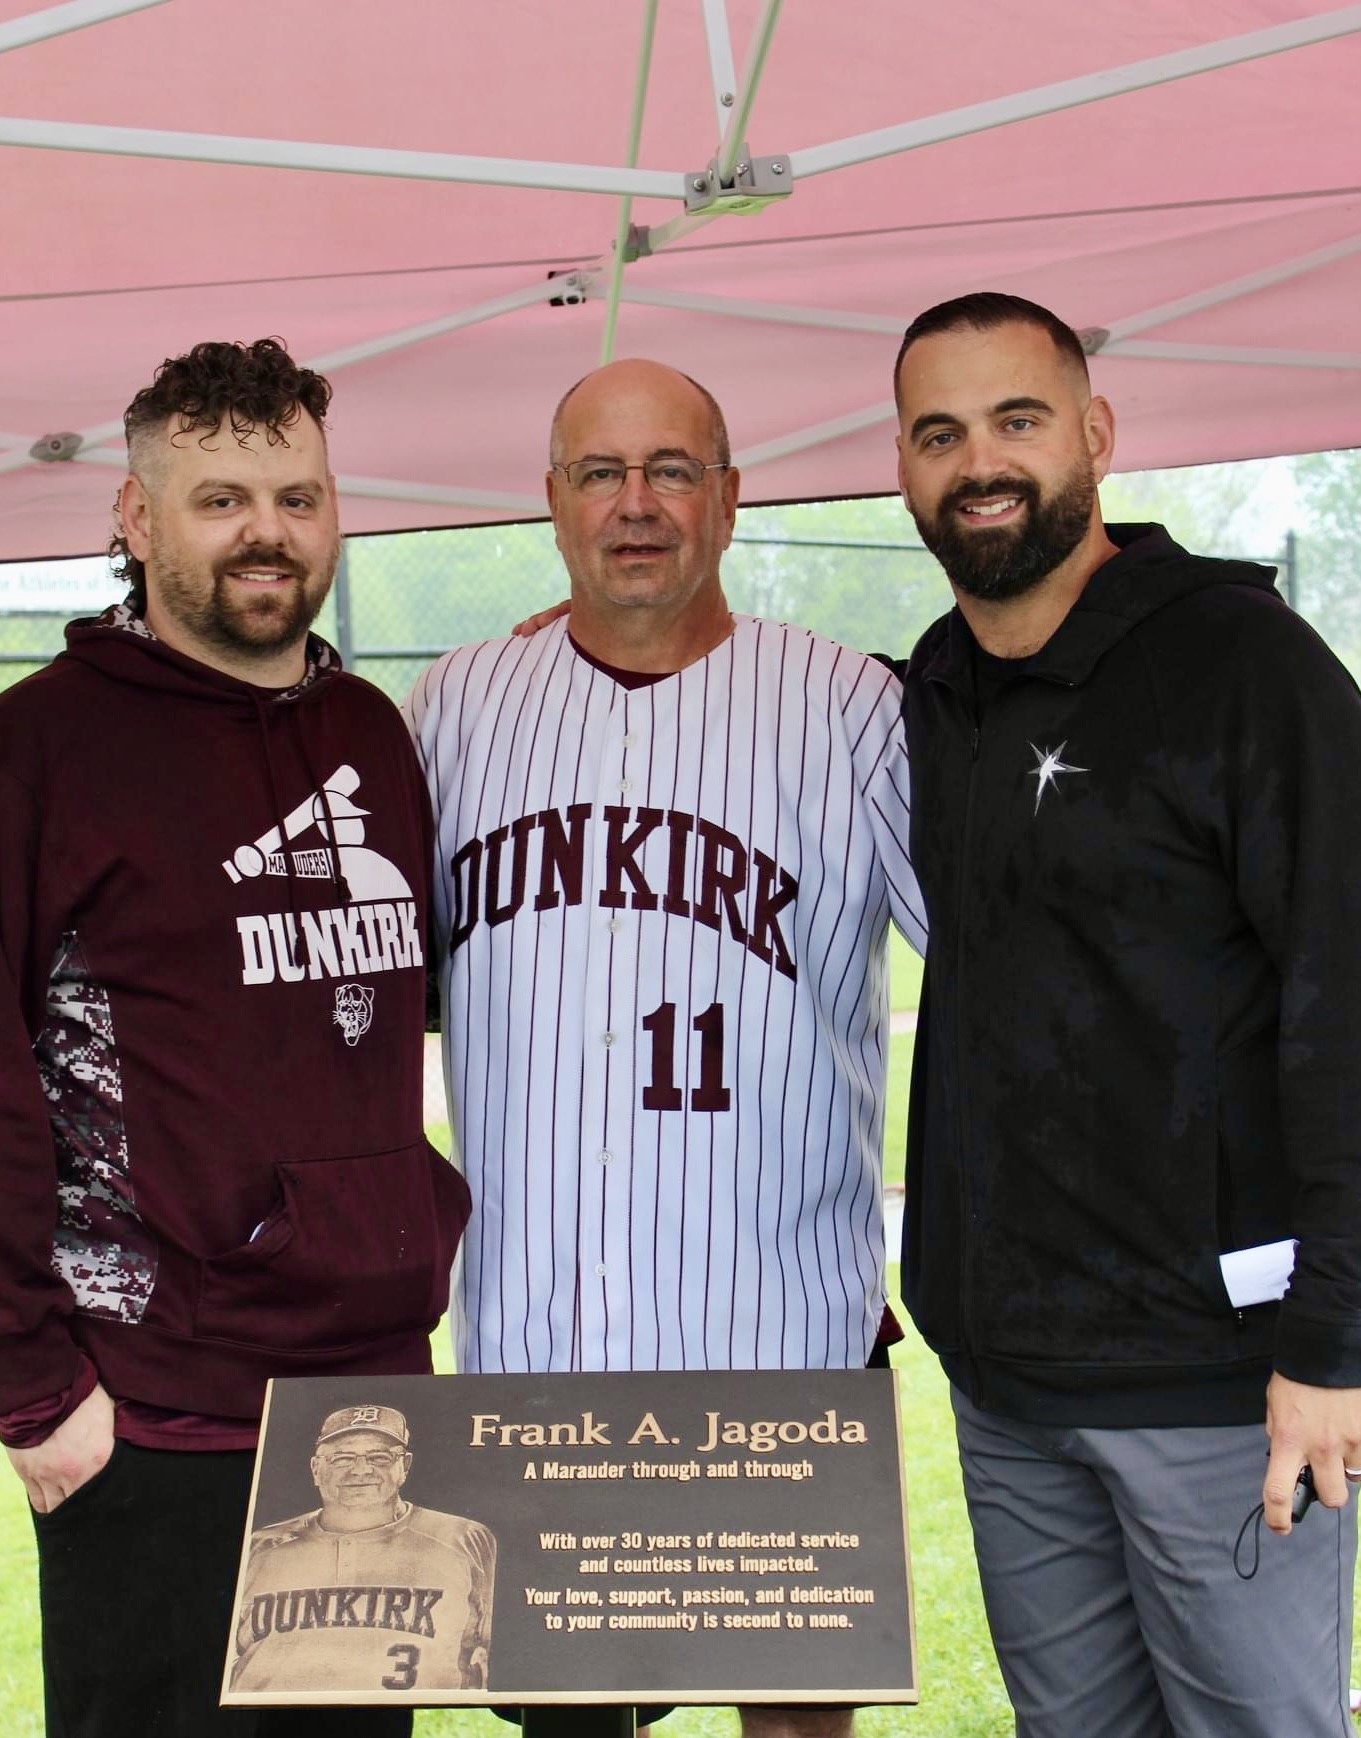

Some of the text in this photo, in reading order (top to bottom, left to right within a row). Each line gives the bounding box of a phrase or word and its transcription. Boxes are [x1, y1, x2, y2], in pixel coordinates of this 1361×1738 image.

[268, 851, 328, 876] MAUDERS
[450, 803, 798, 984] DUNKIRK
[236, 902, 424, 985] DUNKIRK
[643, 1002, 731, 1112] 11
[469, 1410, 868, 1452] Frank A. Jagoda
[524, 1460, 813, 1480] A Marauder through and through
[540, 1532, 859, 1552] With over 30 years of dedicated service
[579, 1556, 818, 1575] and countless lives impacted.
[252, 1586, 443, 1642] DUNKIRK
[525, 1587, 874, 1608] Your love, support, passion, and dedication
[545, 1612, 853, 1632] to your community is second to none.
[381, 1643, 421, 1690] 3
